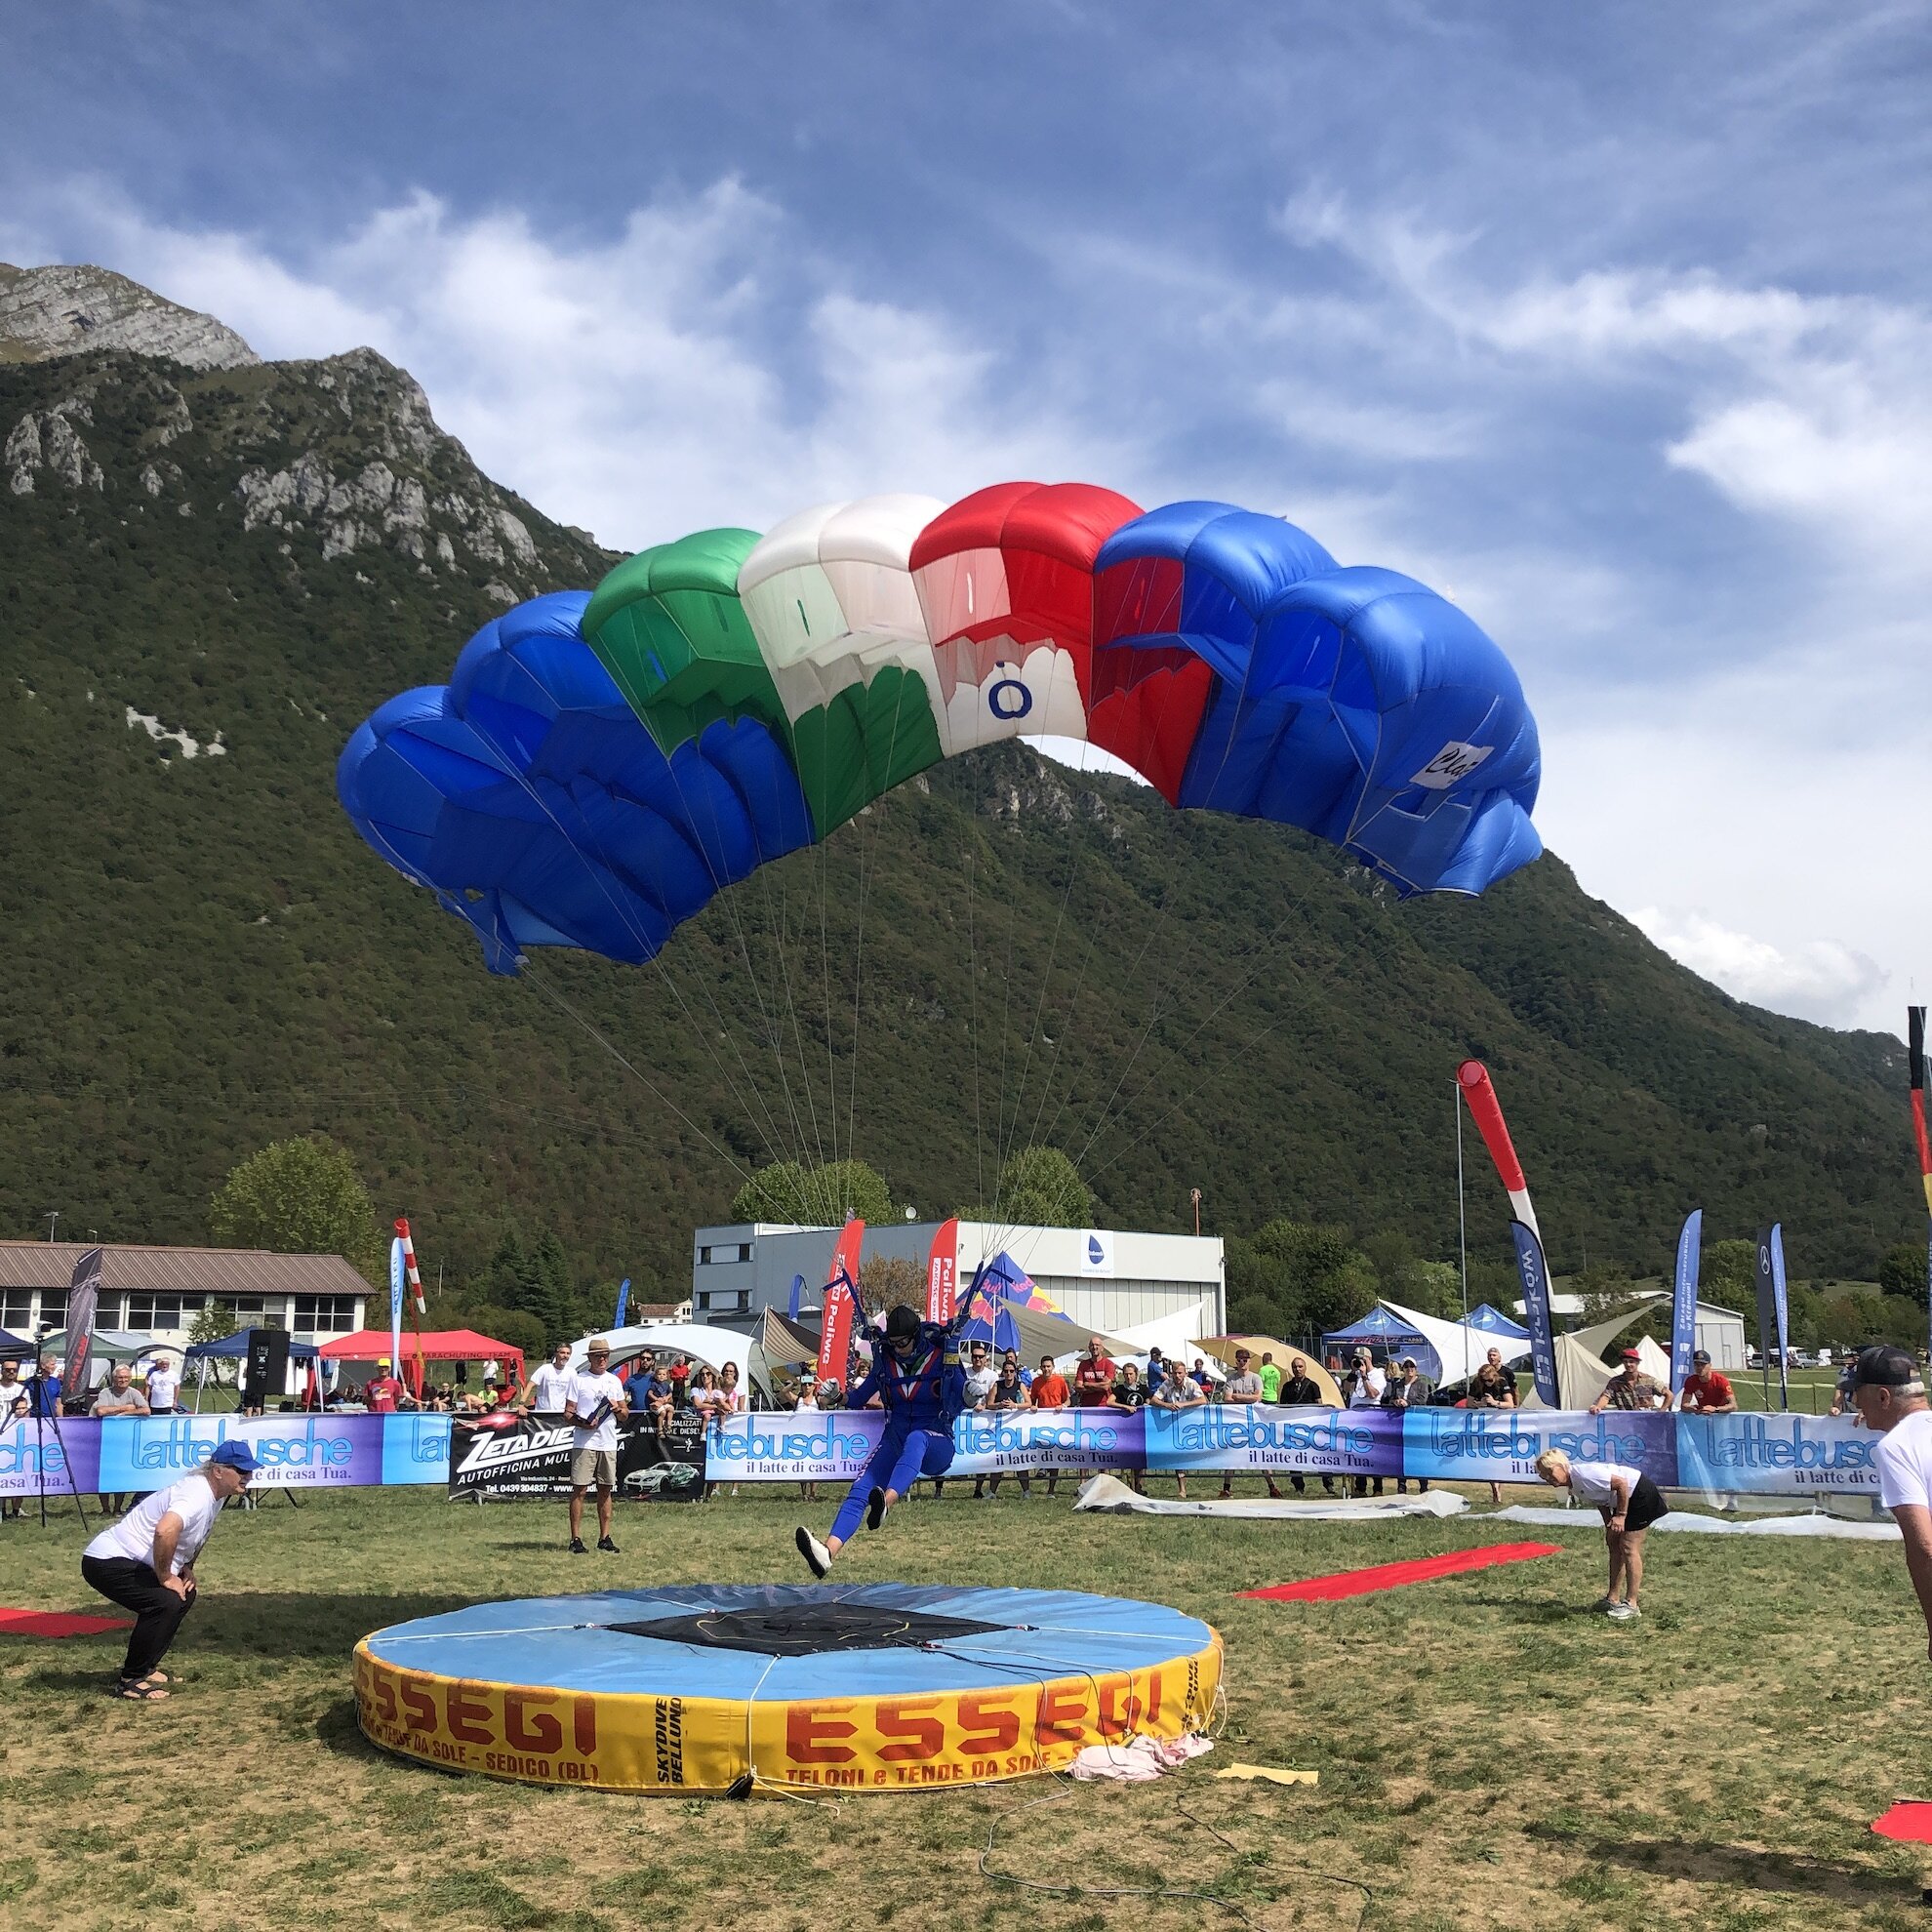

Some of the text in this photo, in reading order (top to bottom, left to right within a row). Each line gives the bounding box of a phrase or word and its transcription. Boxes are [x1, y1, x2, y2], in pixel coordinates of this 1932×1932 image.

[943, 1258, 952, 1320] Paliwa
[1171, 1405, 1375, 1453] lattebusche
[1707, 1416, 1881, 1469] lattebusc
[457, 1426, 574, 1474] ZETADIE
[746, 1462, 754, 1473] il
[759, 1462, 787, 1473] latte
[791, 1462, 804, 1473] di
[809, 1464, 836, 1472] casa
[996, 1450, 1118, 1466] il latte di casa Tua.
[1249, 1450, 1375, 1468] il latte di casa Tua.
[1511, 1461, 1519, 1473] il
[266, 1468, 280, 1480] di
[286, 1469, 316, 1479] casa
[320, 1467, 352, 1479] Tua.
[458, 1457, 540, 1485] AUTOFFICINA
[1795, 1471, 1805, 1484] il
[1809, 1471, 1844, 1484] latte
[1849, 1471, 1866, 1484] di
[786, 1670, 1161, 1763] ESSEGI
[414, 1734, 429, 1754] DA
[432, 1741, 466, 1763] SOLE
[485, 1751, 549, 1777] SEDICO
[558, 1763, 599, 1781] (BL)
[656, 1698, 669, 1784] SKYDIVE
[669, 1698, 683, 1783] BELLUNO
[785, 1768, 865, 1787] TELONI
[896, 1765, 961, 1784] TENDE
[972, 1759, 997, 1779] DA
[1006, 1752, 1051, 1775] SOLE
